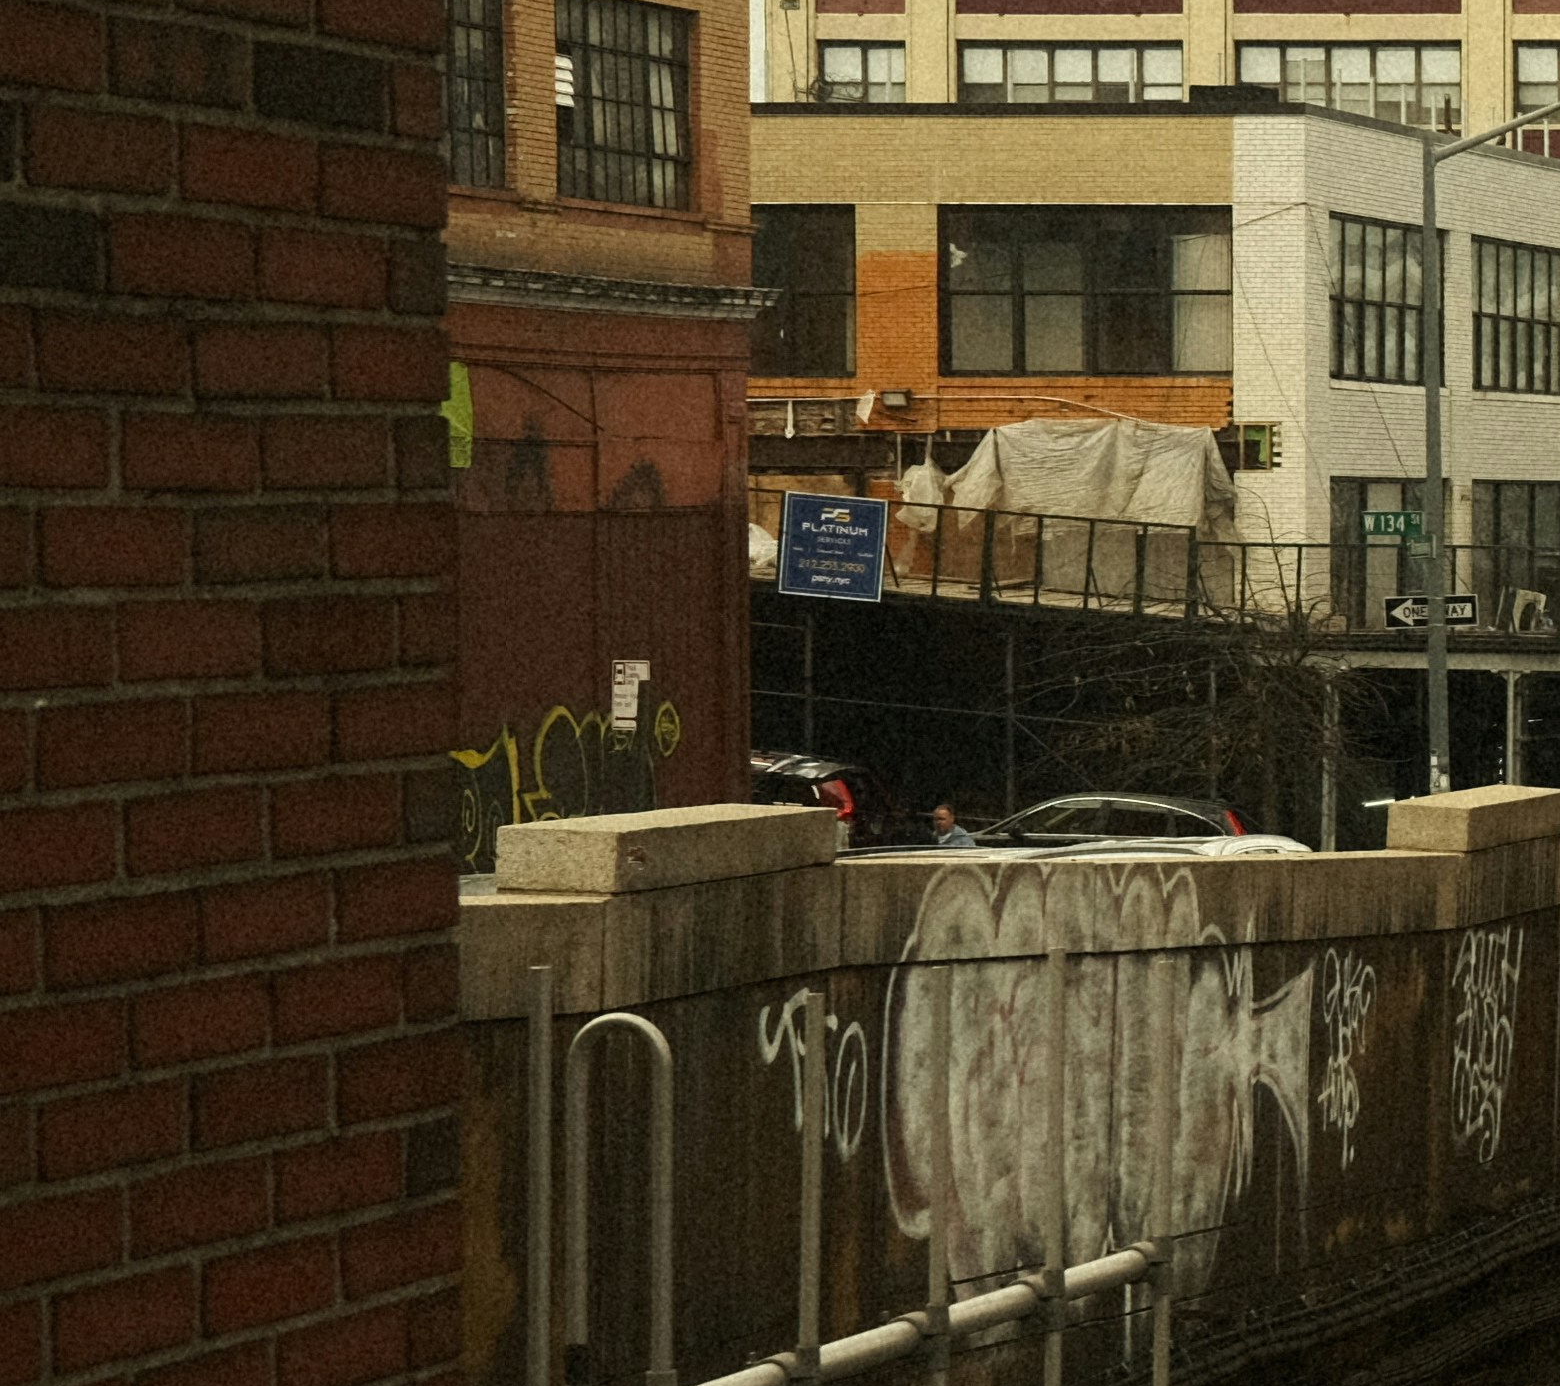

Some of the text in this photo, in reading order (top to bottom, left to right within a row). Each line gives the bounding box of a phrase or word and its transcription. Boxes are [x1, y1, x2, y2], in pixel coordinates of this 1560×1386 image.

[802, 522, 869, 536] PLATINUM
[1364, 515, 1375, 531] W
[1381, 515, 1405, 531] 134
[1403, 604, 1467, 618] ONE AY
